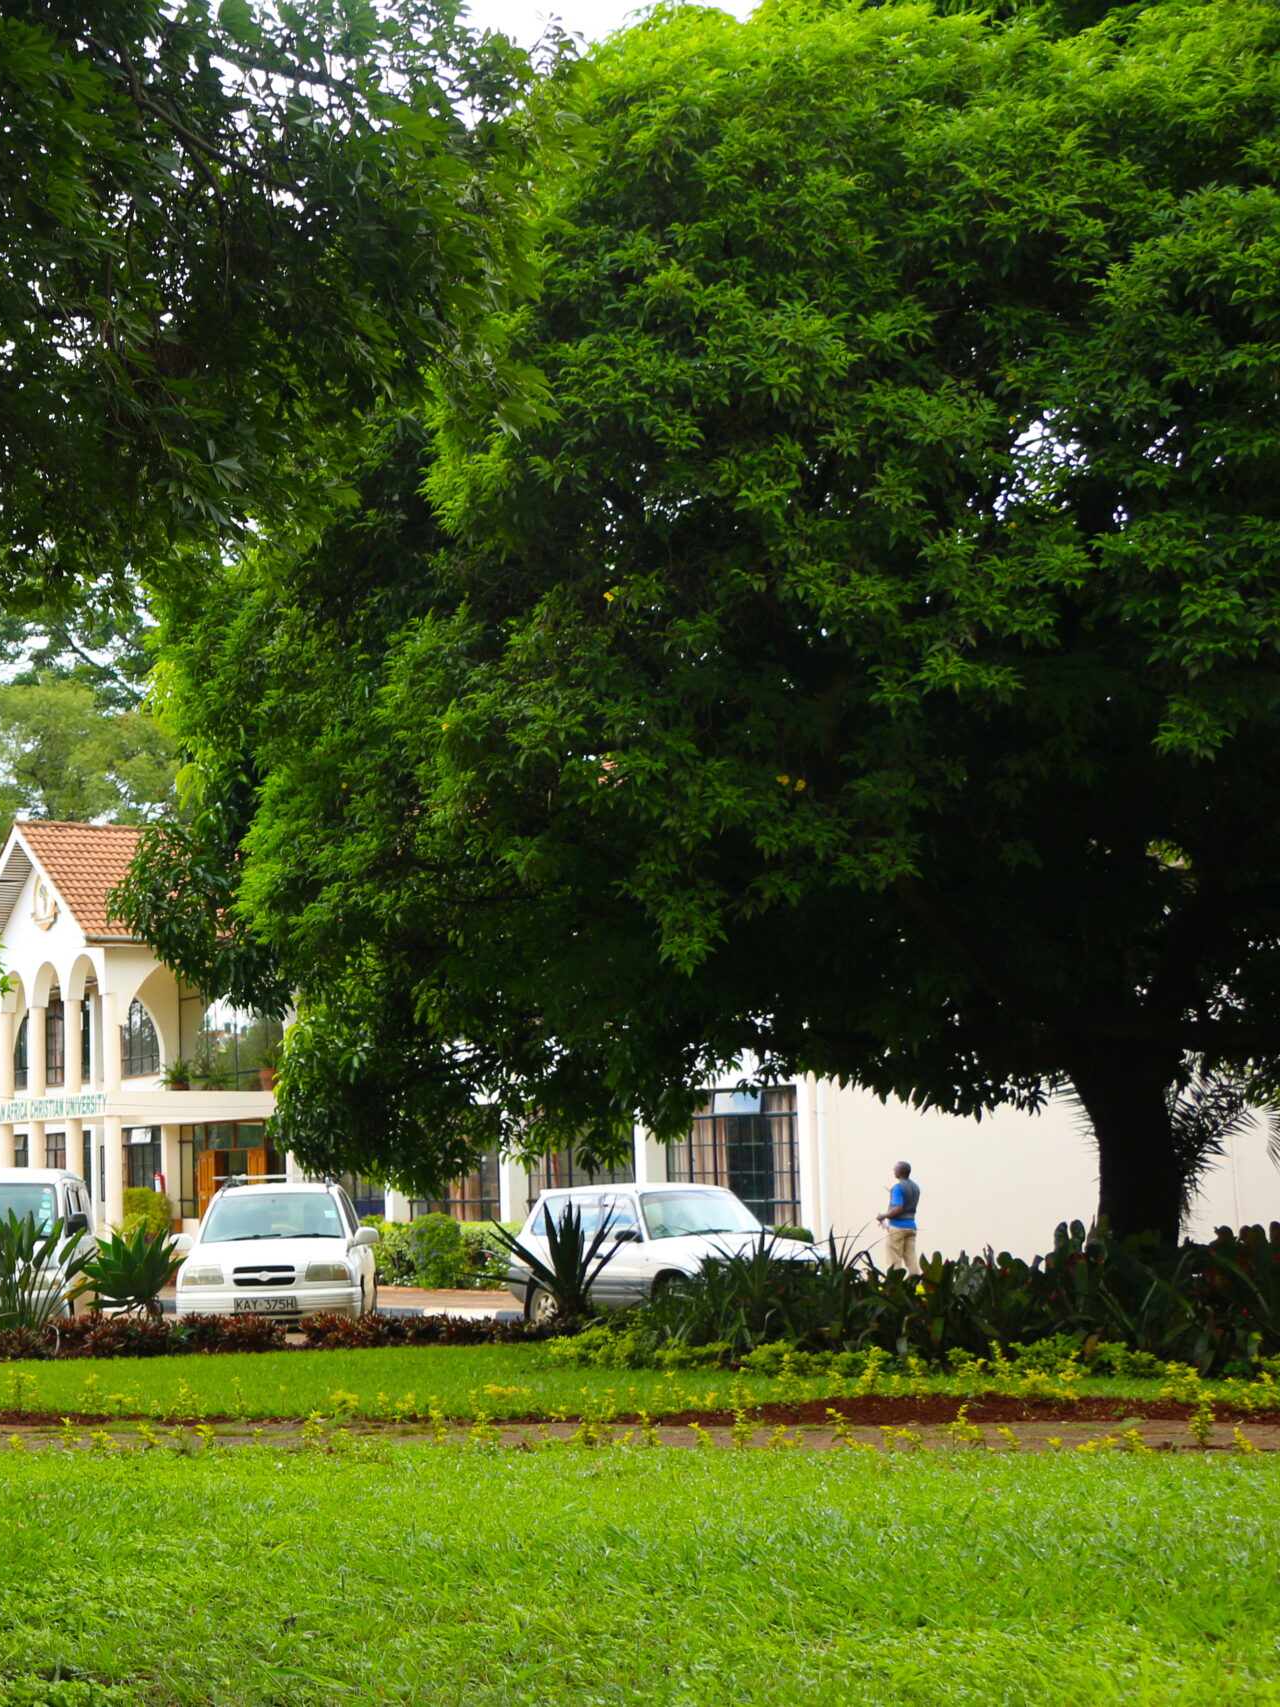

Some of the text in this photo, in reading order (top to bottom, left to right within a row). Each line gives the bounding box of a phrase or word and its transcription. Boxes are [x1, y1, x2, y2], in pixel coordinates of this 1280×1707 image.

[7, 1101, 28, 1120] AFRICA
[30, 1098, 64, 1118] CHRISTIAN
[66, 1093, 108, 1115] UNIVERSITY
[236, 1298, 294, 1310] KAY 375H
